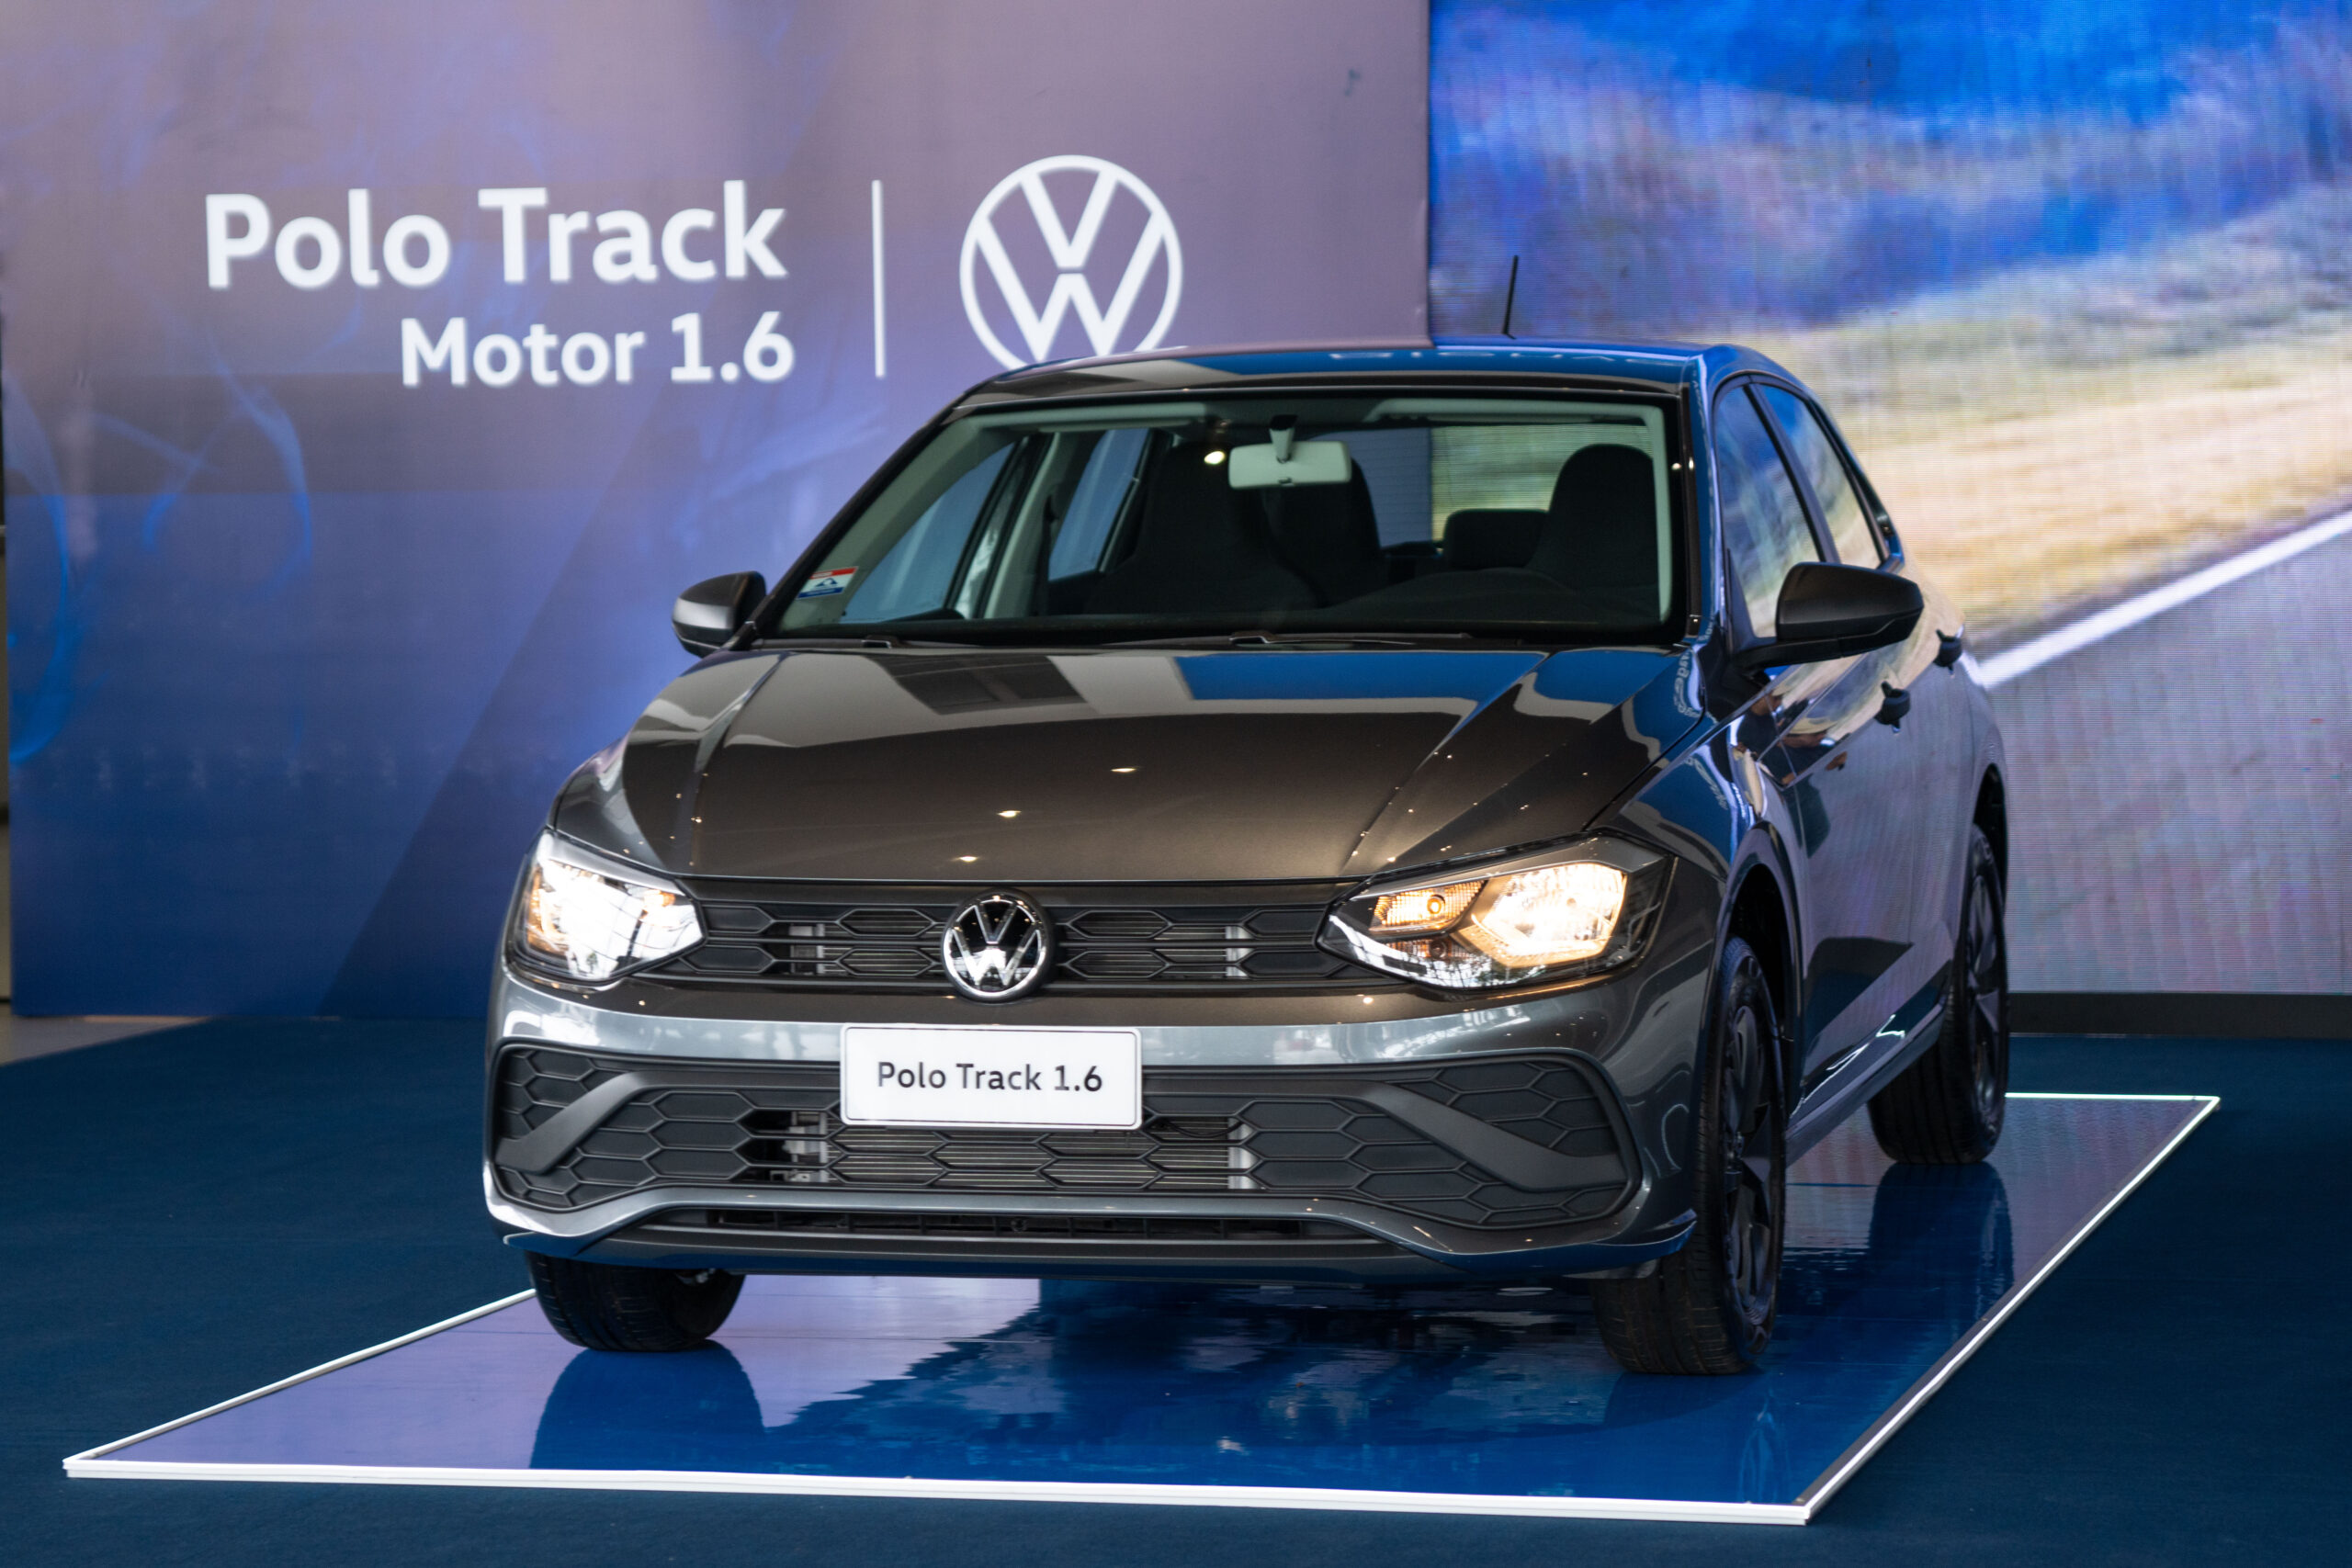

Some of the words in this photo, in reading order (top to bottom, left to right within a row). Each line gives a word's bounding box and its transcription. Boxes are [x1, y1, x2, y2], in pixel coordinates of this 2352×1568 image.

[205, 187, 451, 289] Polo
[478, 179, 788, 284] Track
[963, 158, 1178, 367] VW
[401, 316, 646, 386] Motor
[671, 310, 795, 382] 1.6
[877, 1061, 947, 1089] Polo
[956, 1063, 1042, 1091] Track
[1054, 1065, 1103, 1092] 1.6
